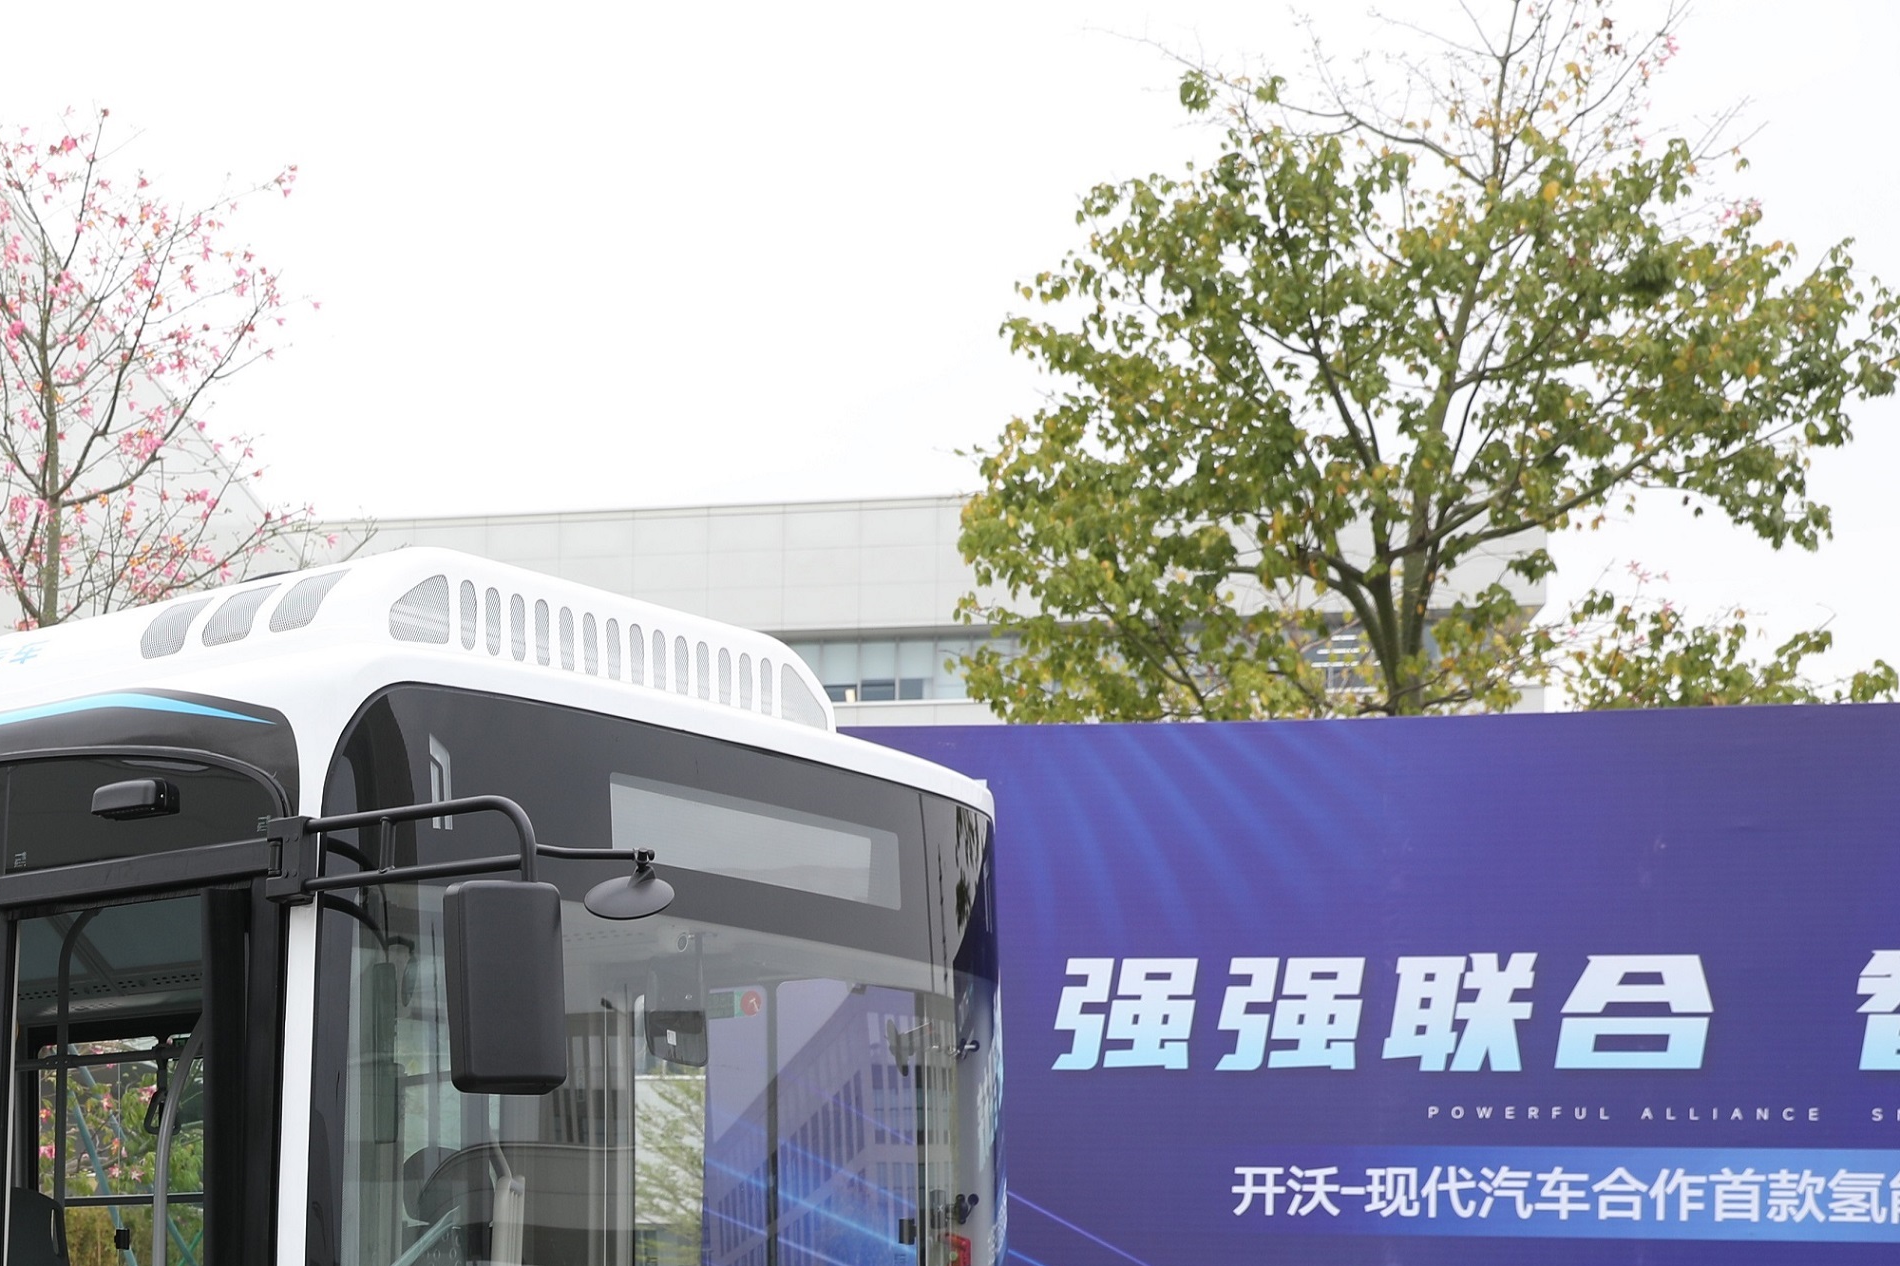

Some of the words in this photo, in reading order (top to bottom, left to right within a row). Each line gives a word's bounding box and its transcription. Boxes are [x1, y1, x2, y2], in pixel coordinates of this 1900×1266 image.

[1051, 950, 1715, 1072] 强强联合
[1427, 1106, 1610, 1121] POWERFUL
[1640, 1106, 1821, 1122] ALLIANCE
[1231, 1164, 1900, 1225] 开沃-现代汽车合作首款氢
